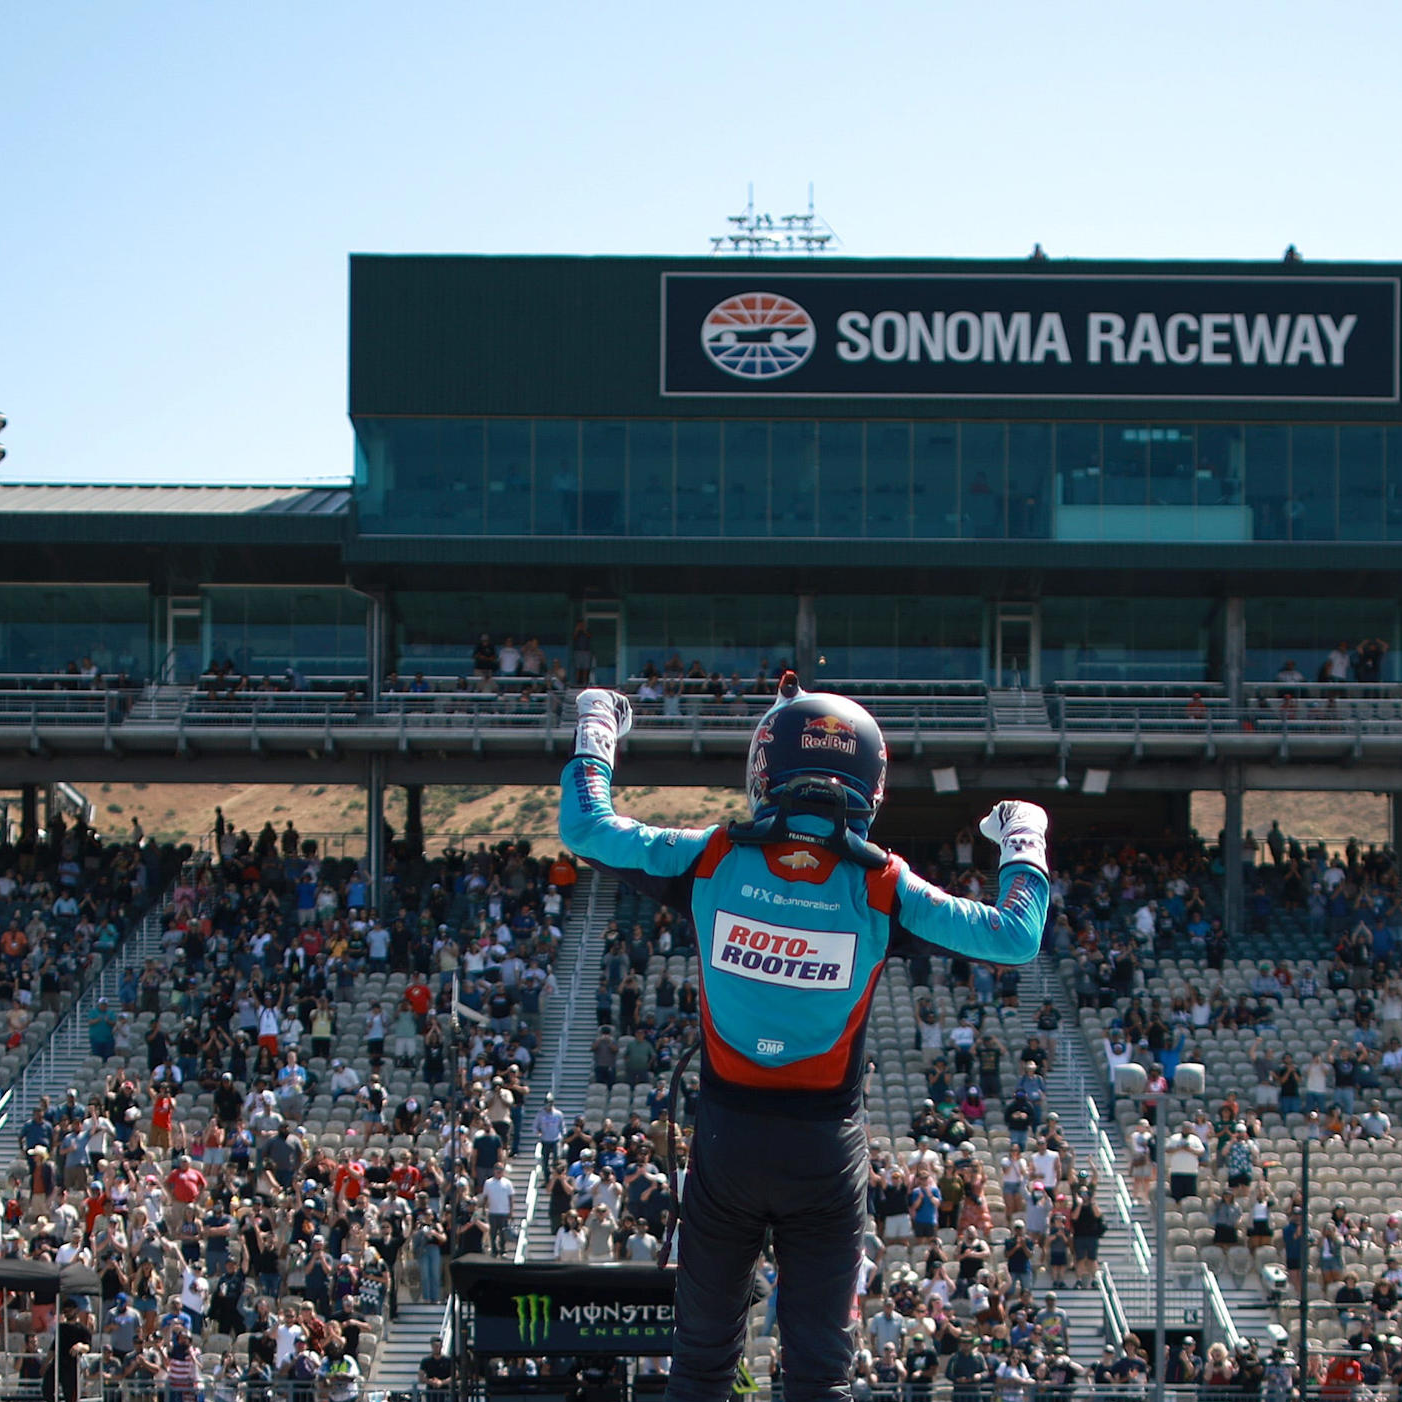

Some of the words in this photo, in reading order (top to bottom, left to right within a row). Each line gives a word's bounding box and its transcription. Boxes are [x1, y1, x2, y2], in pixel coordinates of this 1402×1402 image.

[837, 311, 1072, 363] SONOMA
[1088, 313, 1358, 366] RACEWAY
[728, 925, 819, 958] ROTO-
[721, 944, 841, 981] ROOTER
[756, 1041, 785, 1054] OMP
[560, 1301, 676, 1325] MONSTE
[579, 1327, 671, 1336] ENERGY
